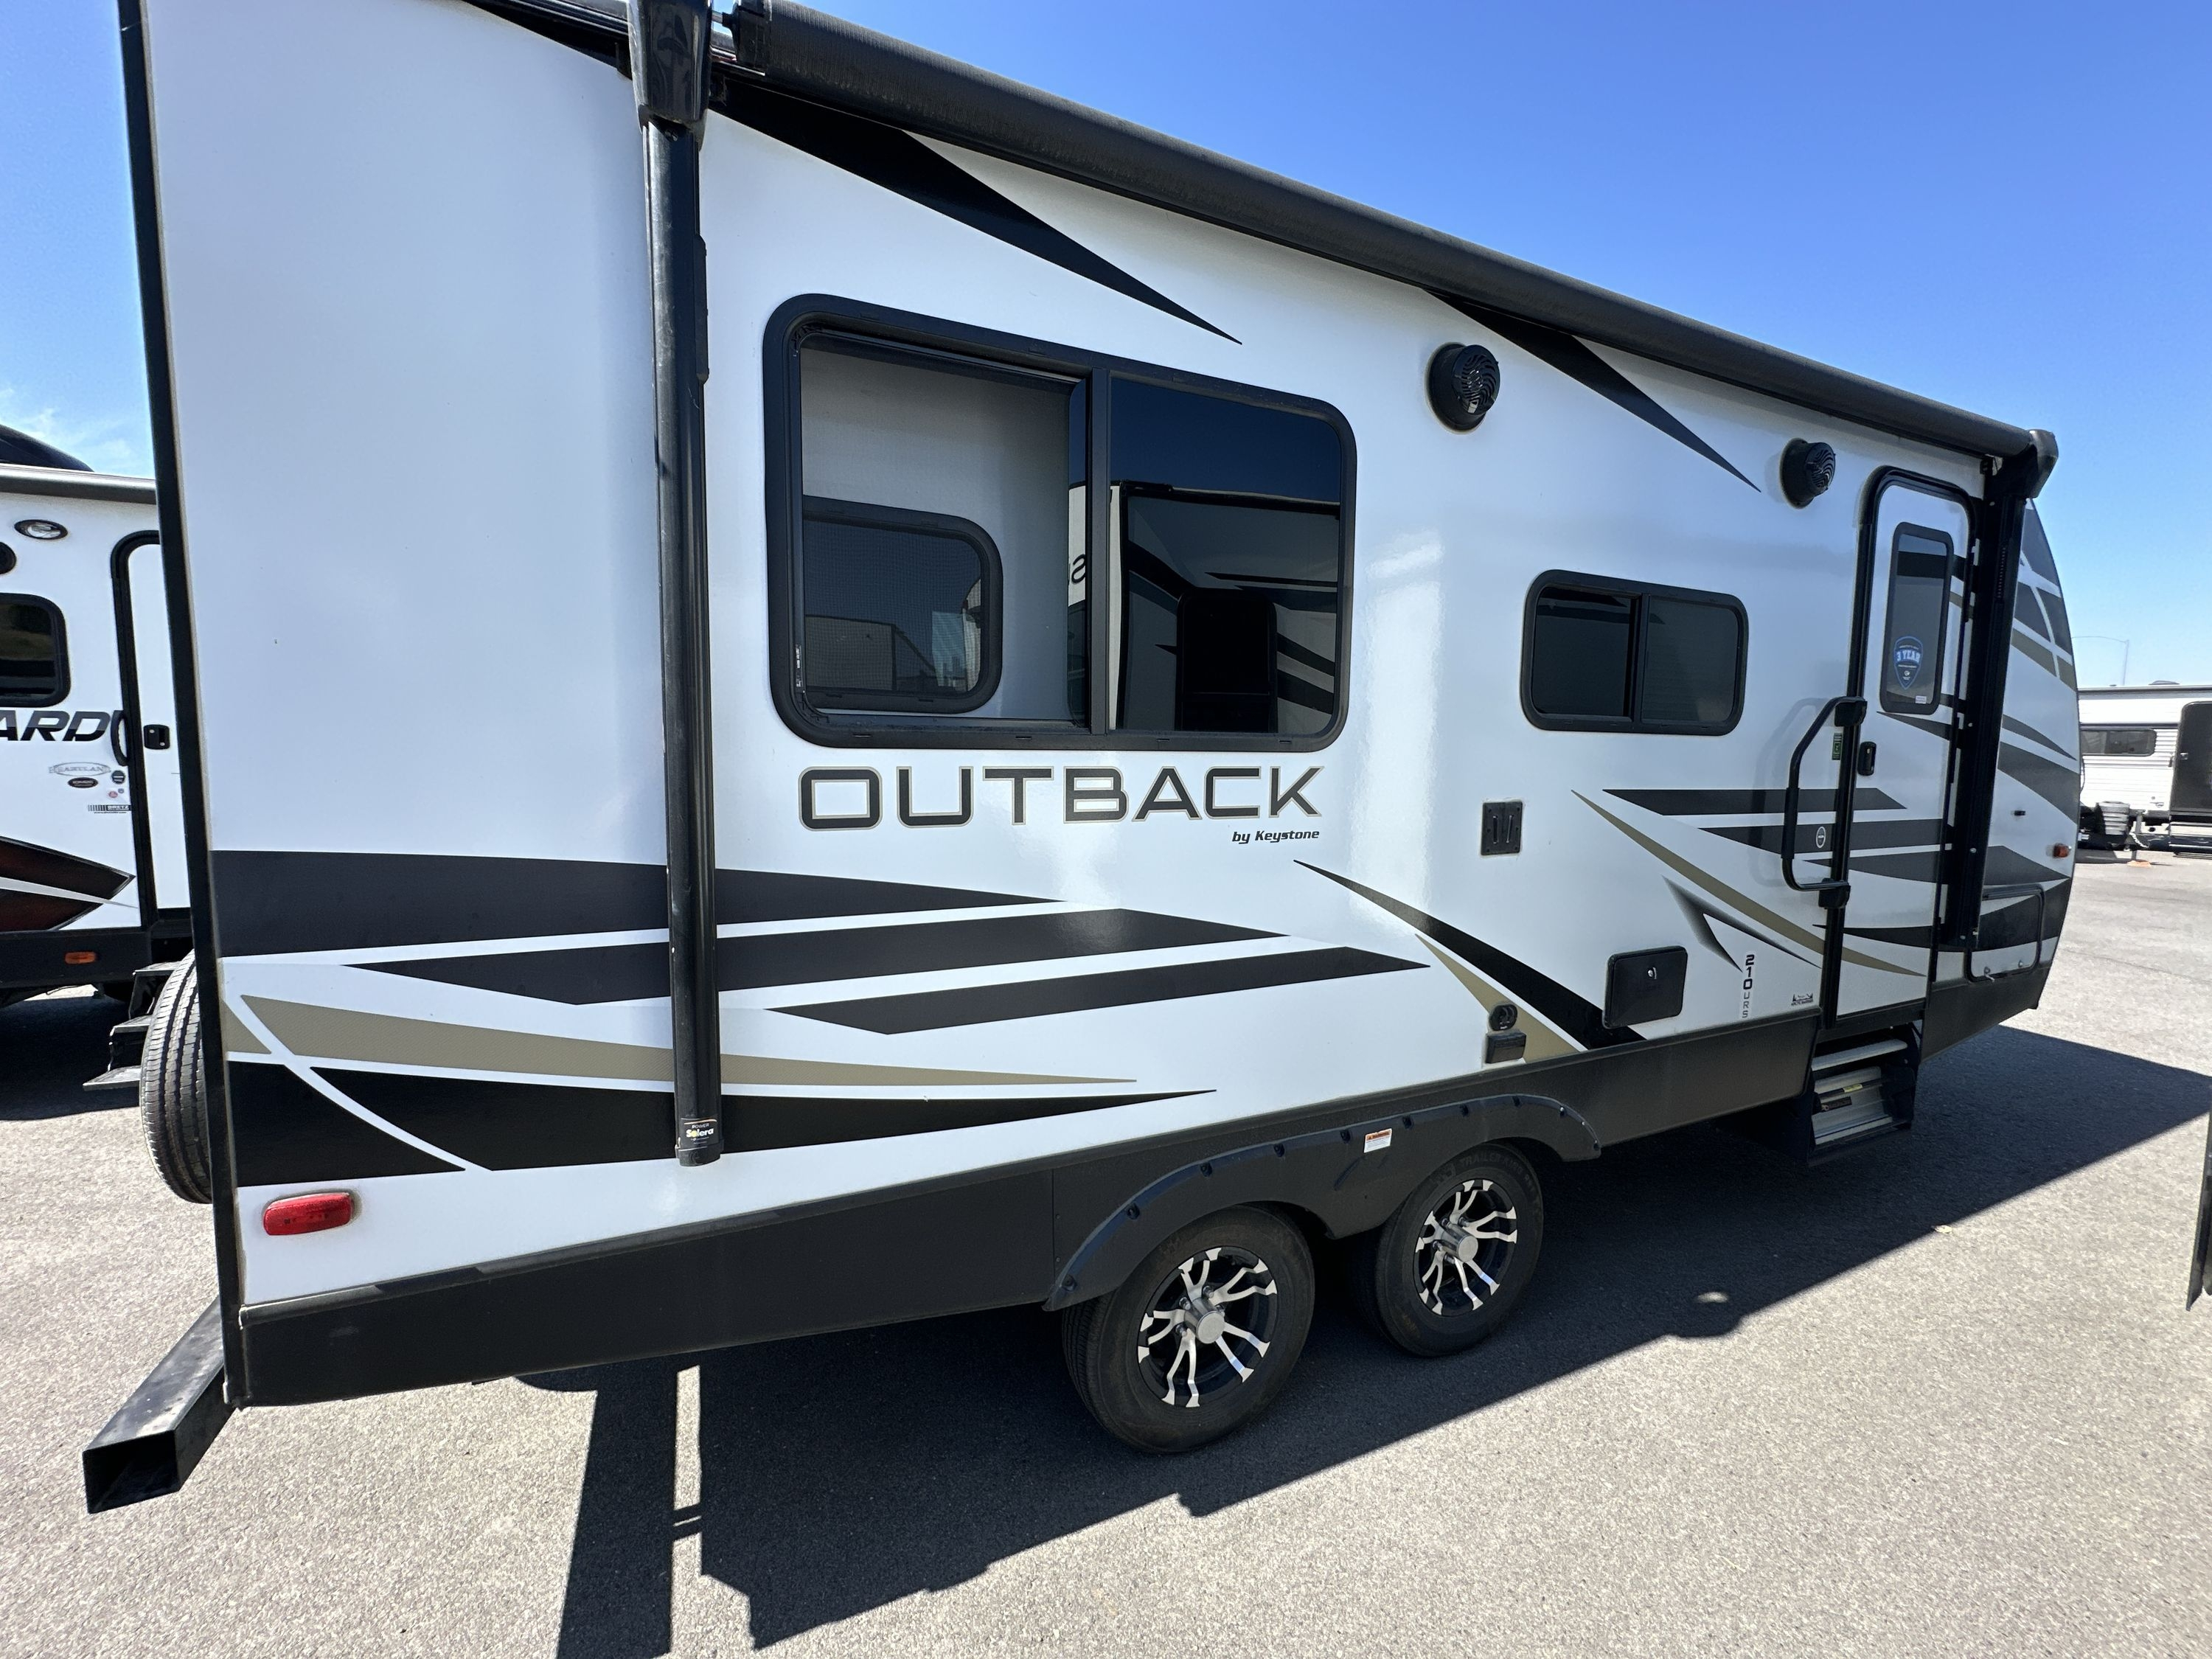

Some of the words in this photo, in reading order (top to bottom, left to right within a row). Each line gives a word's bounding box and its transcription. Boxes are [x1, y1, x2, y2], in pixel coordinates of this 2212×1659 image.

[1902, 650, 1921, 663] YEAR
[797, 766, 1325, 831] OUTBACK
[1232, 831, 1251, 845] by
[1255, 830, 1320, 844] Keystone
[686, 1128, 714, 1137] Solera
